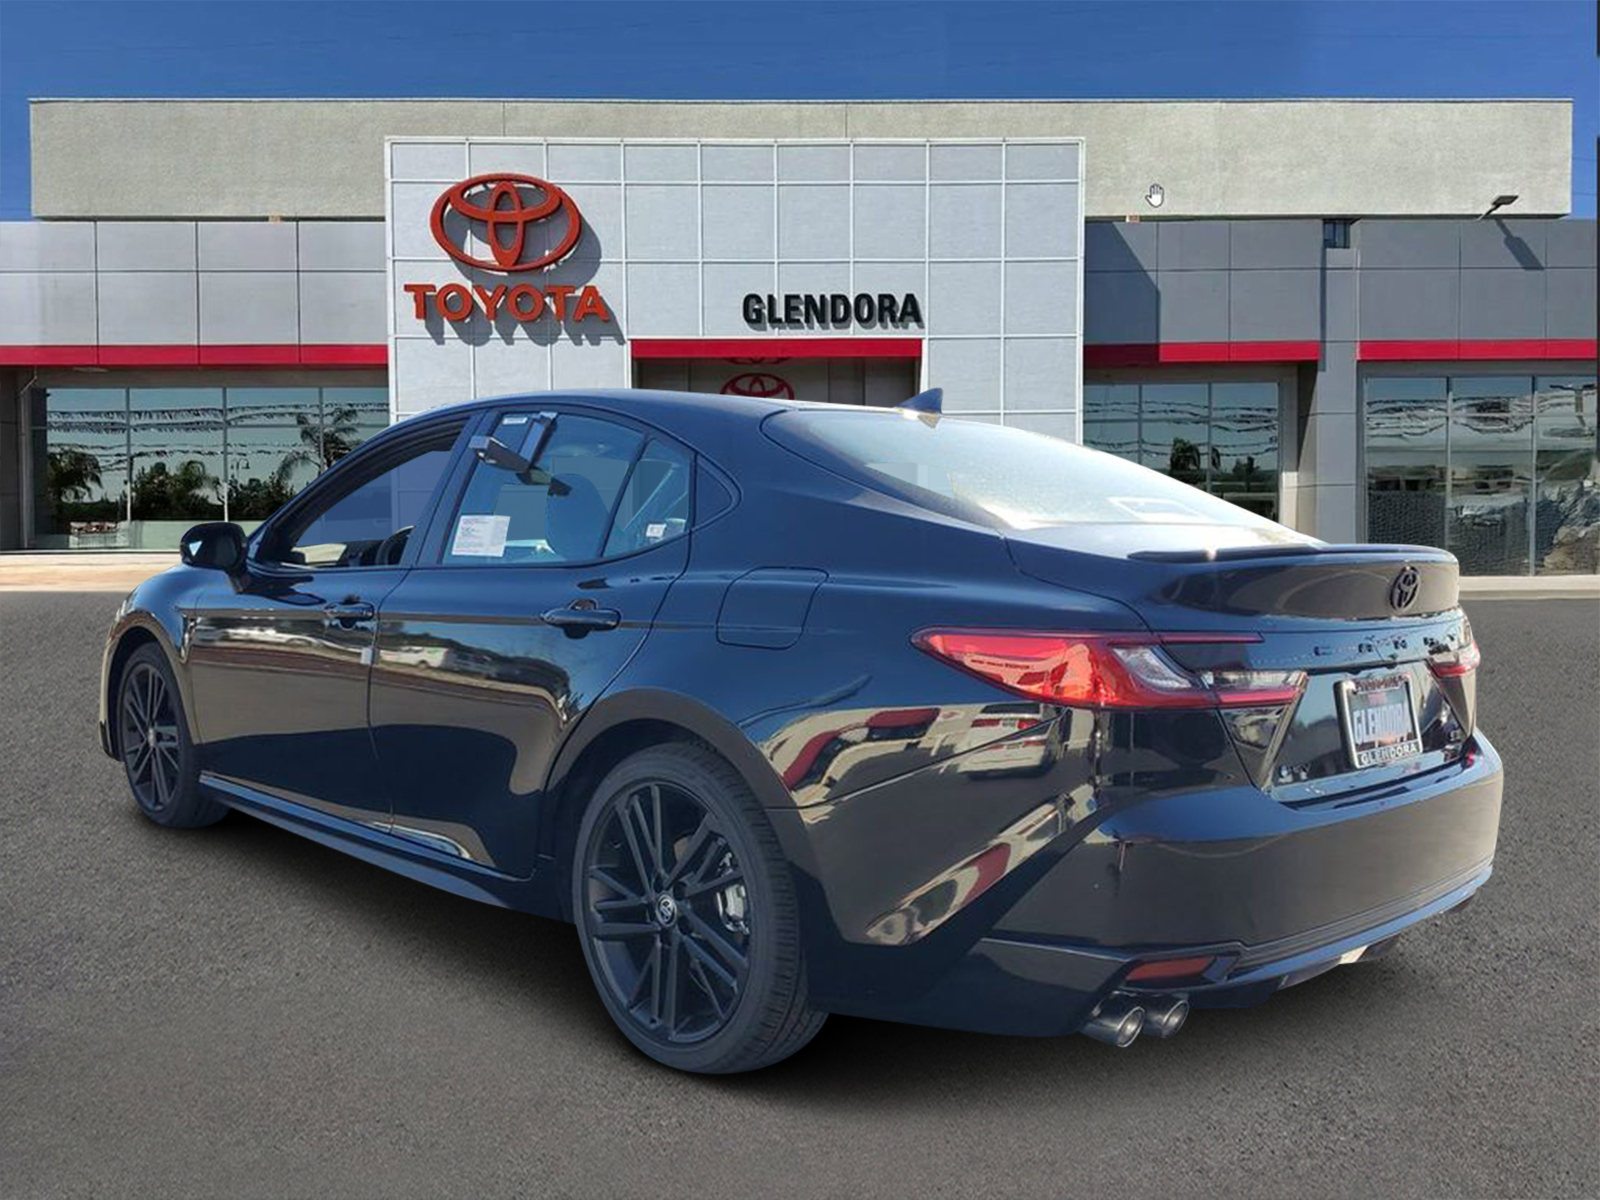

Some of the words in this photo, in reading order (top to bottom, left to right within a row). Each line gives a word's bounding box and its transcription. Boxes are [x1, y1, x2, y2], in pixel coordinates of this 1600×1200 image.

[404, 283, 610, 321] TOYOTA
[742, 293, 922, 326] GLENDORA
[1360, 743, 1418, 764] GLENDORA
